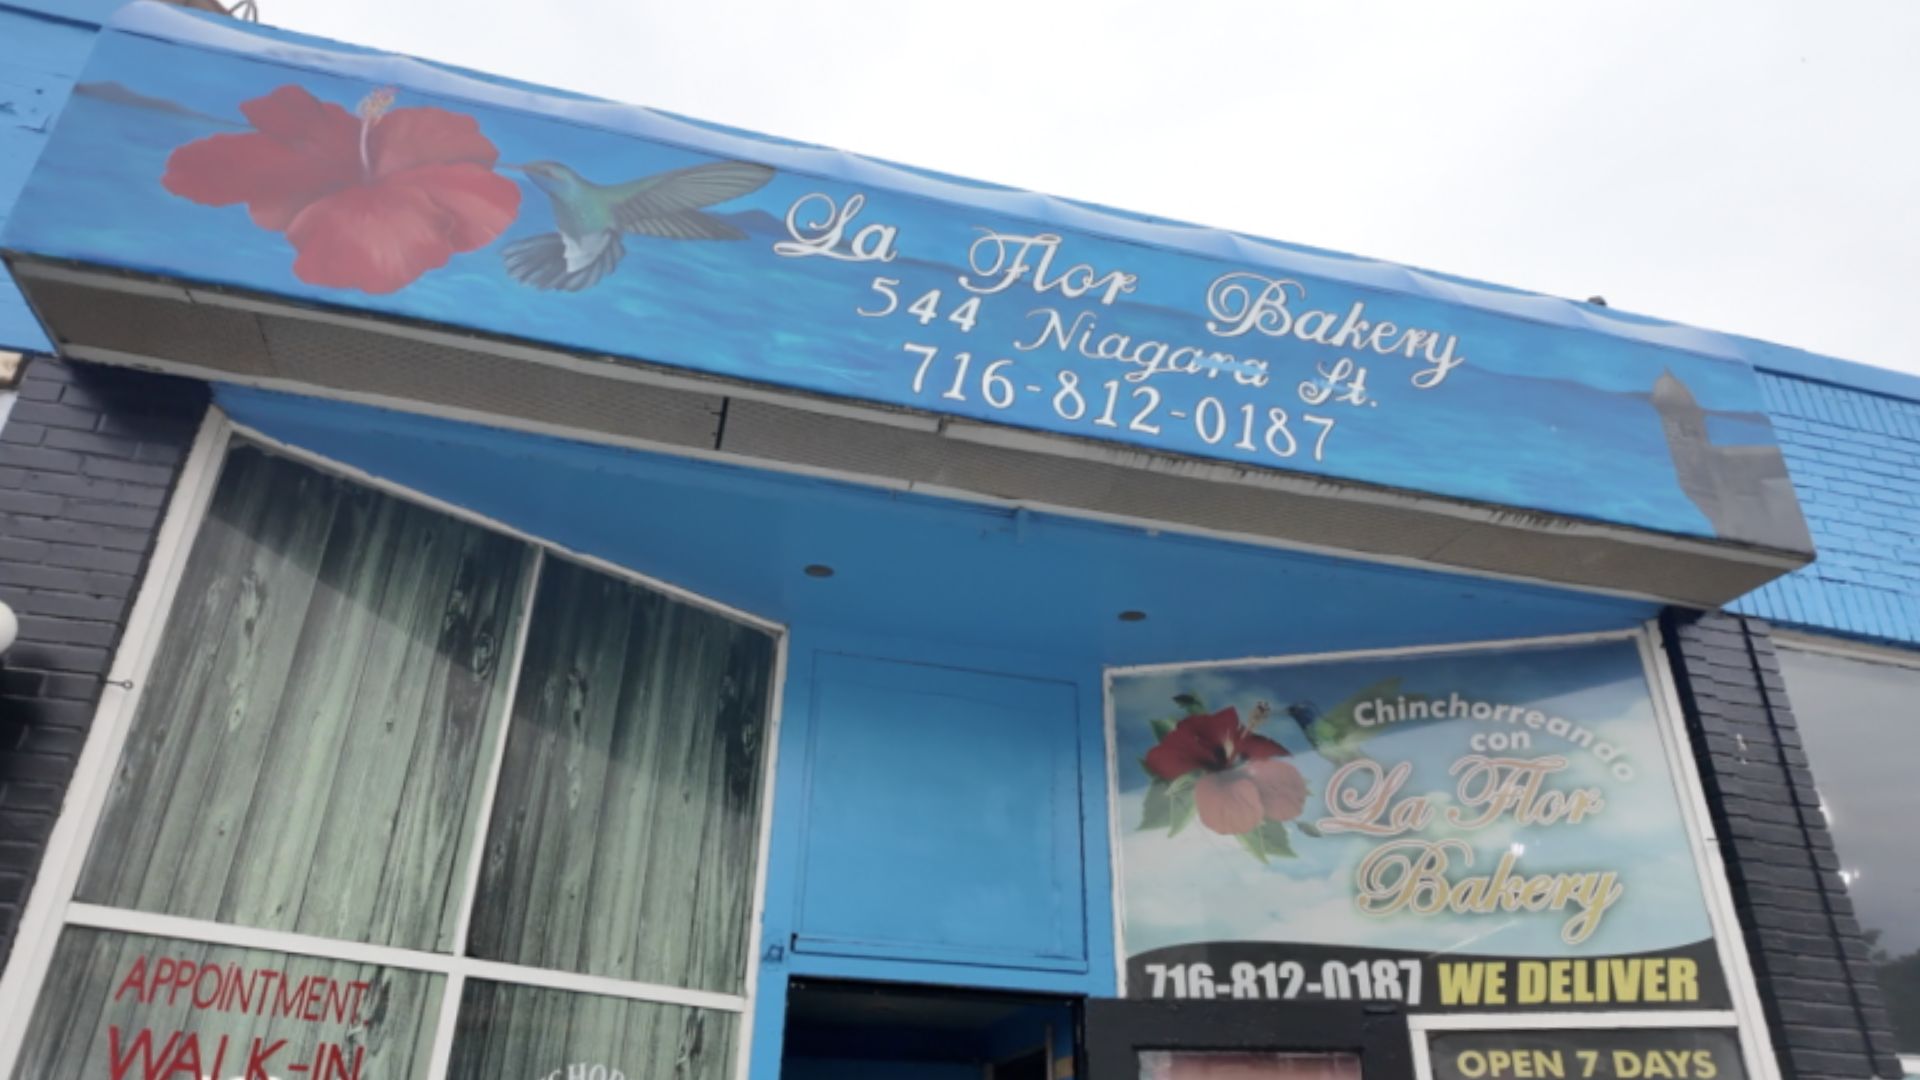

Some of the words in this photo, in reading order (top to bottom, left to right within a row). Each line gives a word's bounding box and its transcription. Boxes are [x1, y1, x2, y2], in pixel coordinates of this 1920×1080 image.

[773, 192, 897, 262] La
[958, 226, 1137, 305] Flor
[1206, 273, 1465, 388] Bakery
[857, 276, 981, 332] 544
[1013, 308, 1270, 388] Niagara
[903, 344, 1335, 462] 716-812-0187
[1353, 692, 1634, 782] Chinchorreando
[1470, 730, 1532, 751] con
[1316, 758, 1434, 836] La
[1447, 755, 1605, 829] Flor
[1356, 839, 1624, 945] Bakery
[1145, 959, 1423, 1006] 716-812-0187
[1438, 960, 1507, 1005] WE
[1518, 957, 1699, 1003] DELIVER
[1456, 1049, 1566, 1078] OPEN
[1575, 1050, 1599, 1078] 7
[1612, 1049, 1718, 1079] DAYS
